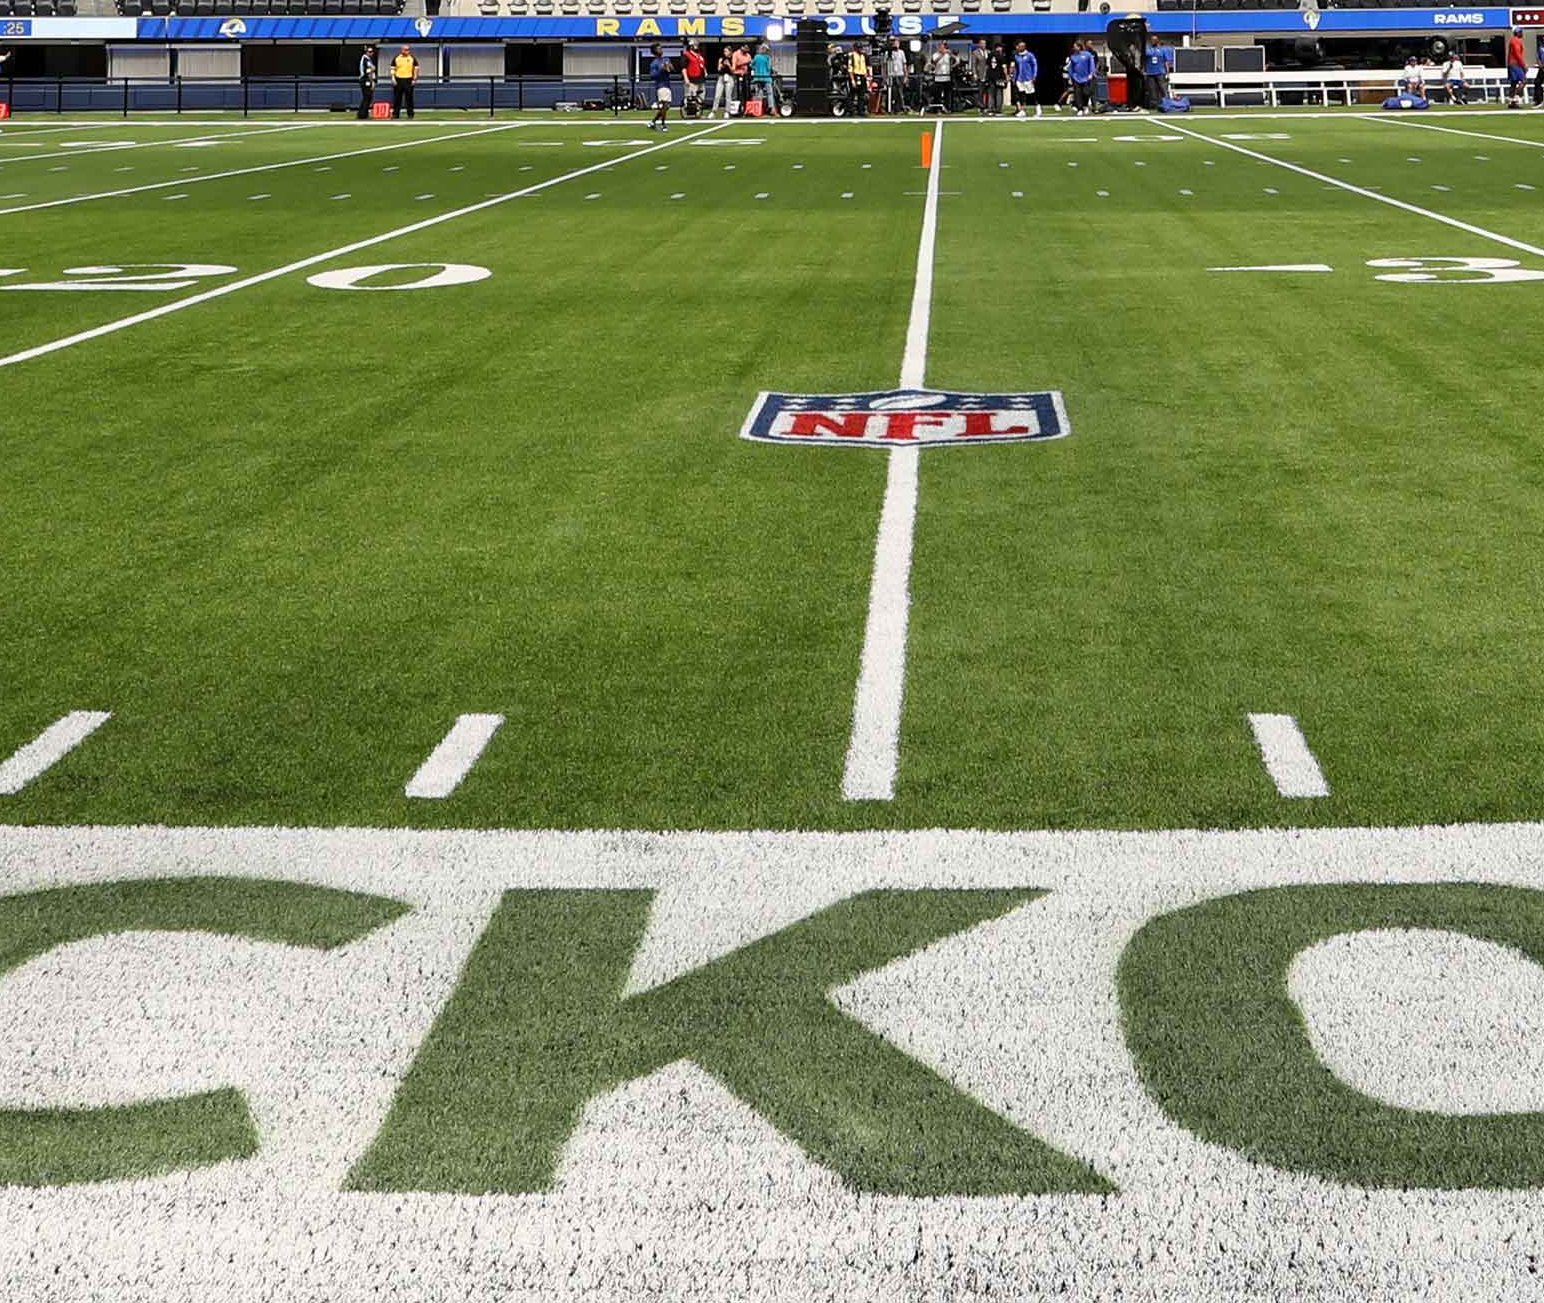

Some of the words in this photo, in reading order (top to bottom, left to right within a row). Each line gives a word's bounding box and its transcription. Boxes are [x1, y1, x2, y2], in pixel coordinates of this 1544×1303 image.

[596, 18, 745, 36] RAMS
[1434, 13, 1484, 24] RAMS
[780, 411, 1029, 441] NFL
